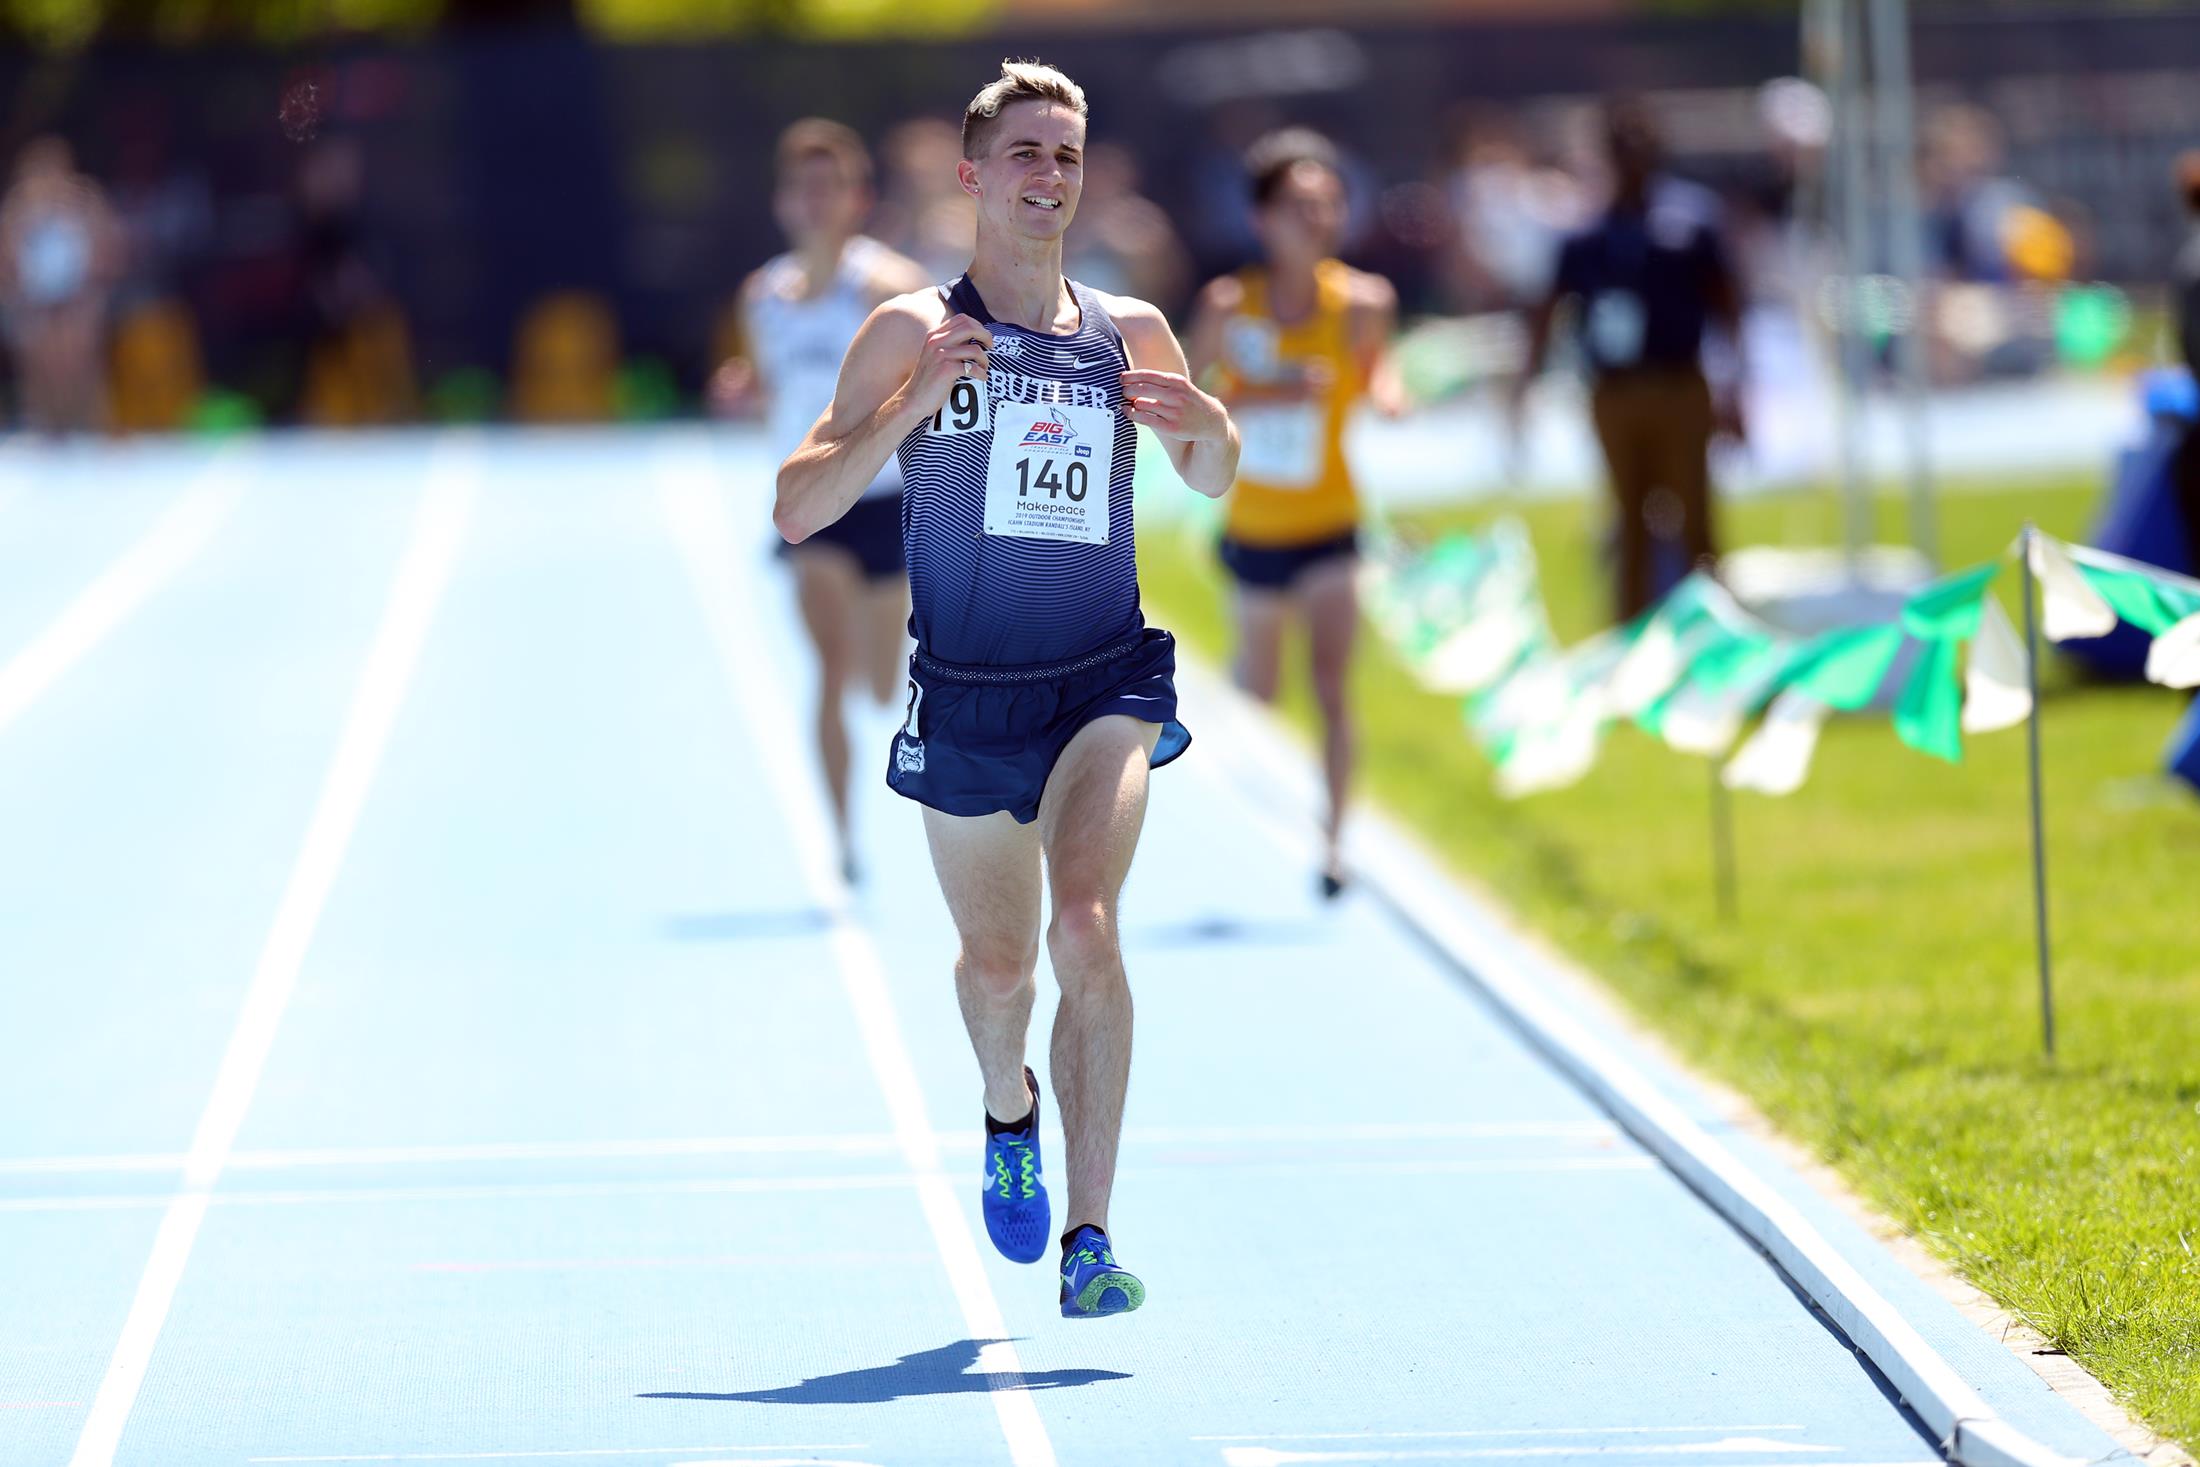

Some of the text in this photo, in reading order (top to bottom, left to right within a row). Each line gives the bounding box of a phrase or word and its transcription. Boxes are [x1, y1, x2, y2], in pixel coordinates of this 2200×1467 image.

[992, 336, 1021, 346] BIG
[989, 369, 1108, 409] BUTLER
[1030, 422, 1064, 434] BIG
[1023, 432, 1074, 444] EAST
[1076, 447, 1090, 456] Jeep
[1016, 457, 1088, 502] 140
[1016, 501, 1086, 516] Makepeace
[1052, 515, 1086, 524] CHAMPIONSHIPS
